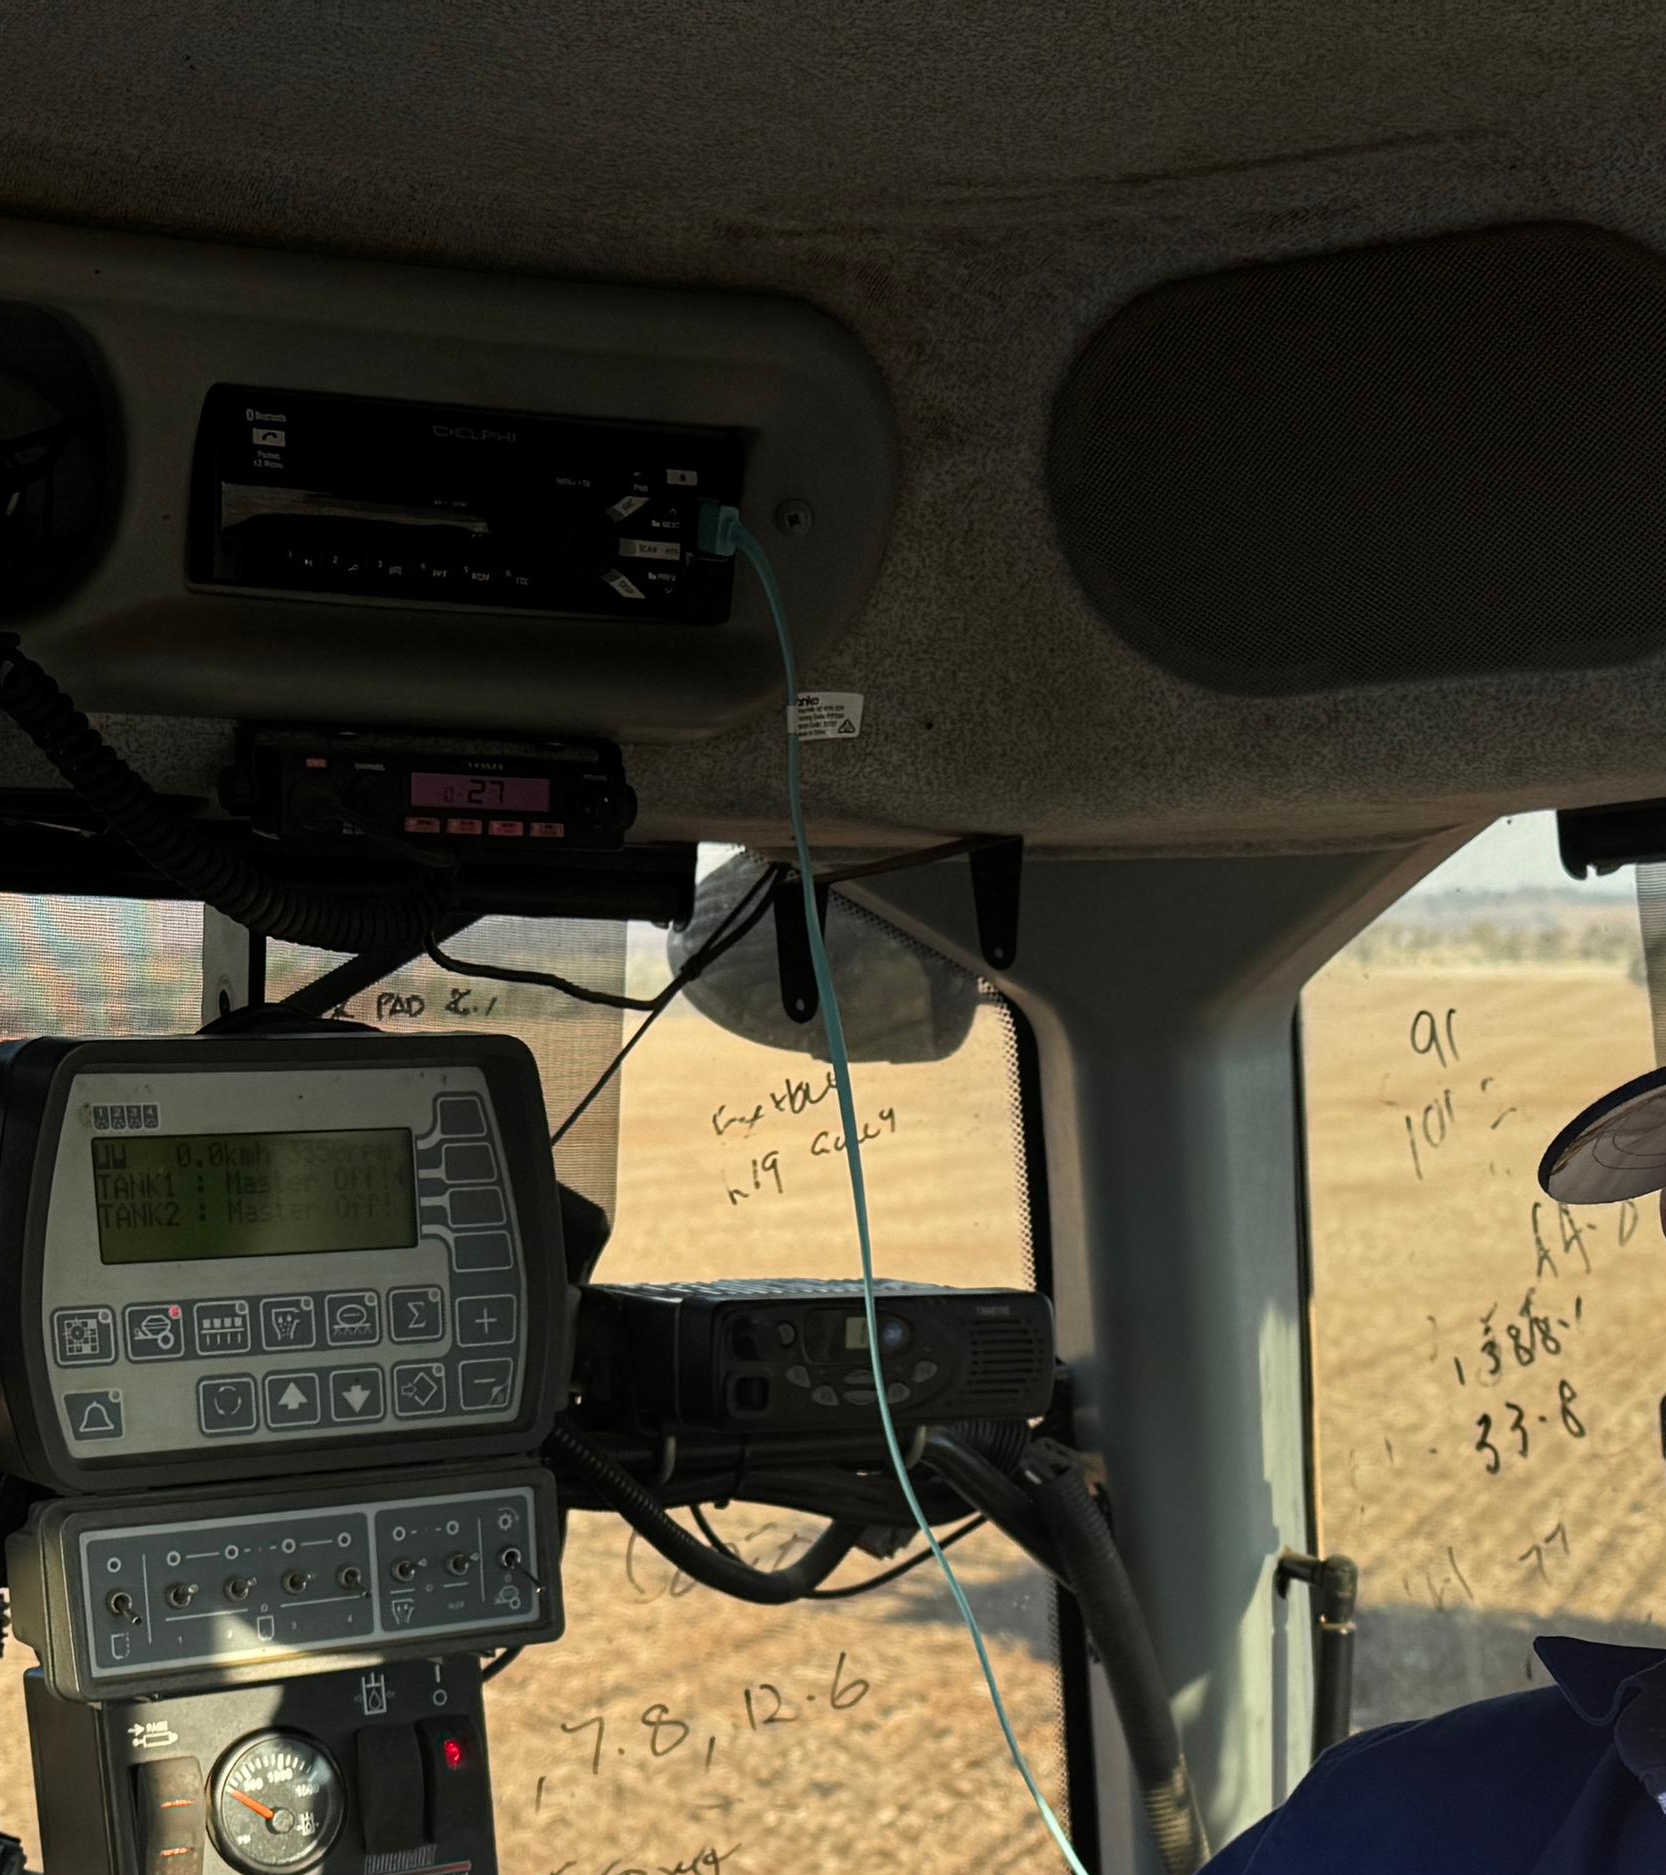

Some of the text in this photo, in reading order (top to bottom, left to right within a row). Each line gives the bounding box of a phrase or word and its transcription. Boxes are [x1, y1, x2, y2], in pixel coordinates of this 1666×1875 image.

[98, 1172, 175, 1200] TANK1
[99, 1201, 181, 1229] TANK2
[1475, 1378, 1587, 1477] 33.8
[743, 1651, 871, 1731] 12.6
[146, 1720, 169, 1732] RAISE
[267, 1767, 293, 1784] 1000
